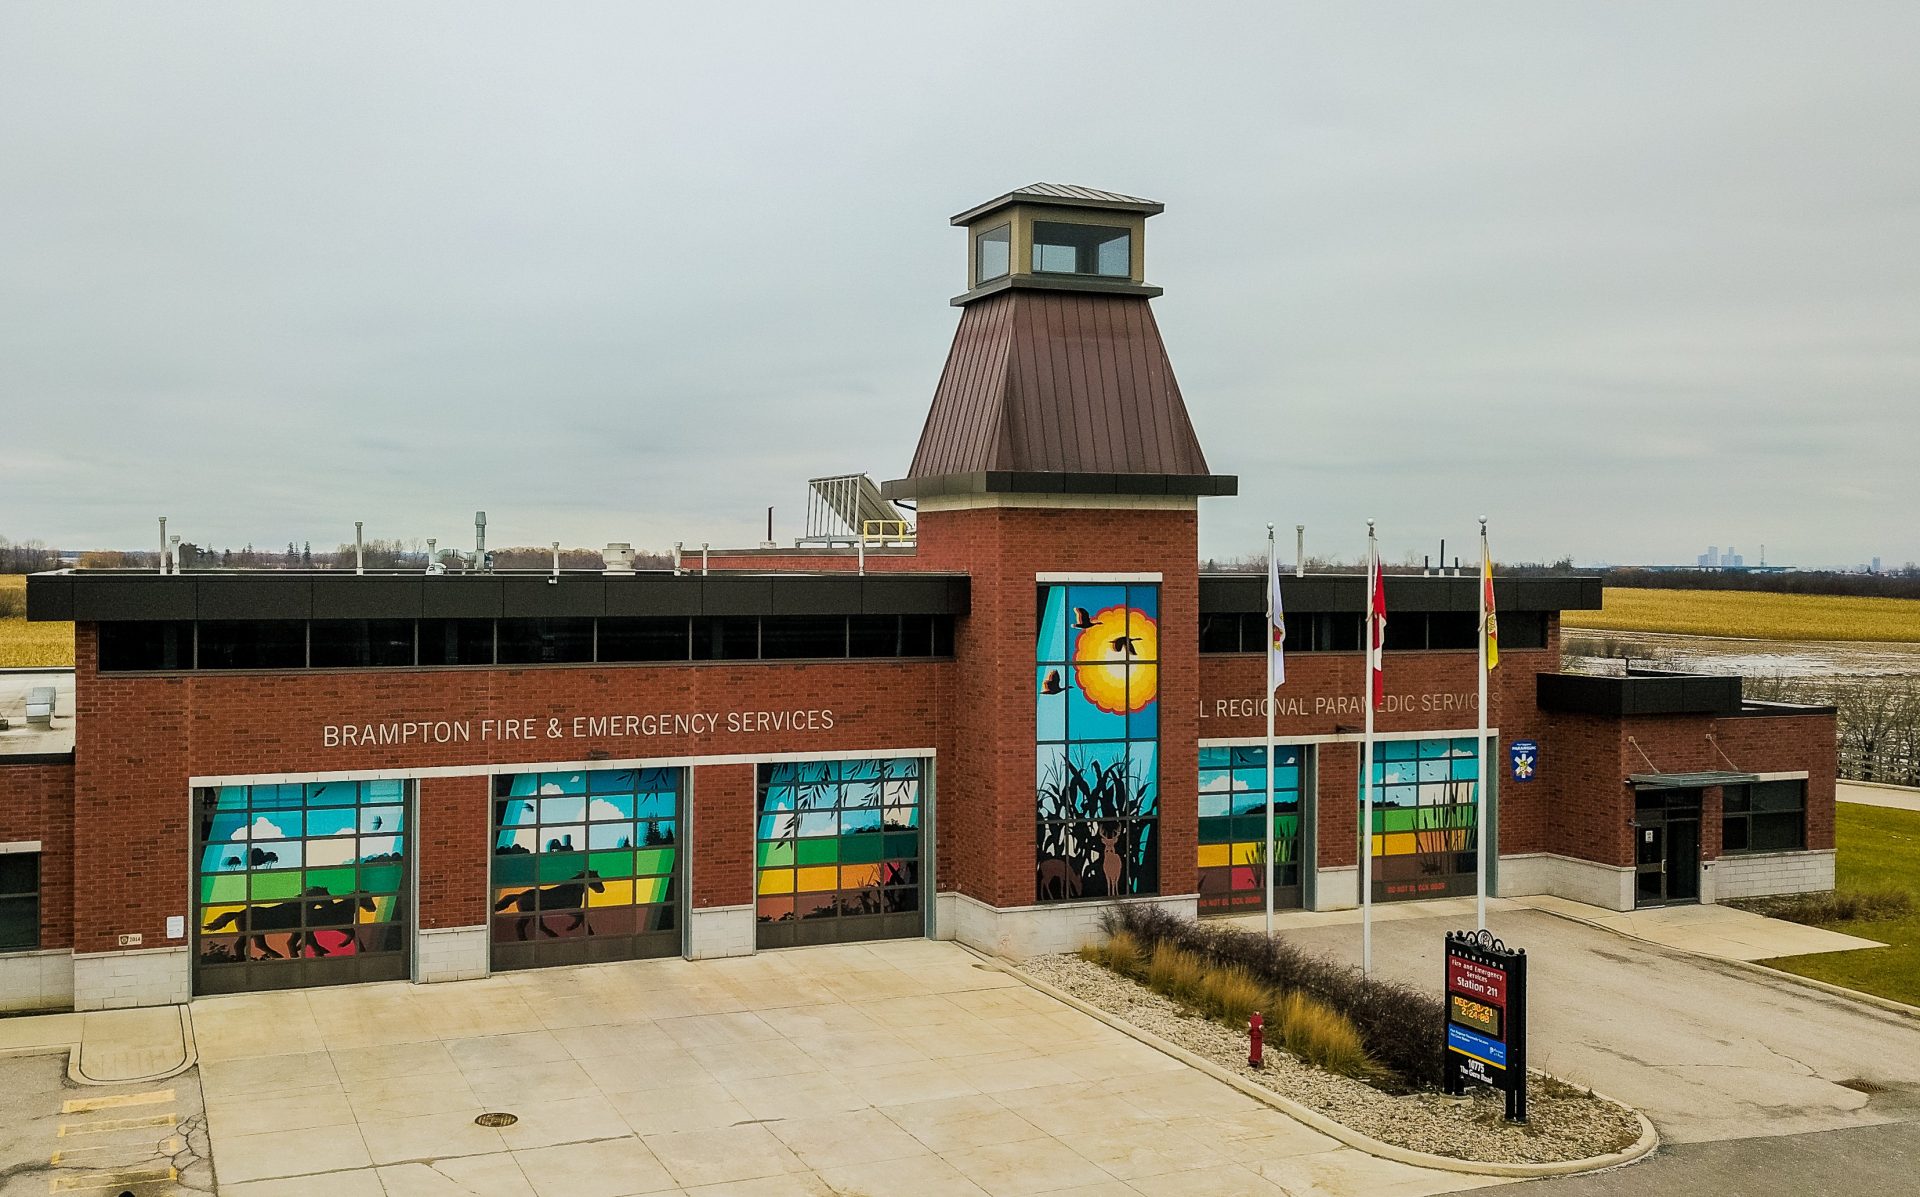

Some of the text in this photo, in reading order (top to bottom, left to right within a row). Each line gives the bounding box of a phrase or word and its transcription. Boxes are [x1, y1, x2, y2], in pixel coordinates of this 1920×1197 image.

[1216, 697, 1309, 718] REGIONAL
[1421, 691, 1503, 713] SERVICS
[323, 709, 834, 748] BRAMPTON FIRE & EMERGENCY SERVICES
[1451, 949, 1504, 970] BRAMPTON
[1451, 959, 1503, 982] Fire and Emergency
[1456, 976, 1498, 998] Station 211
[1466, 971, 1488, 983] Services
[1460, 1065, 1469, 1075] The
